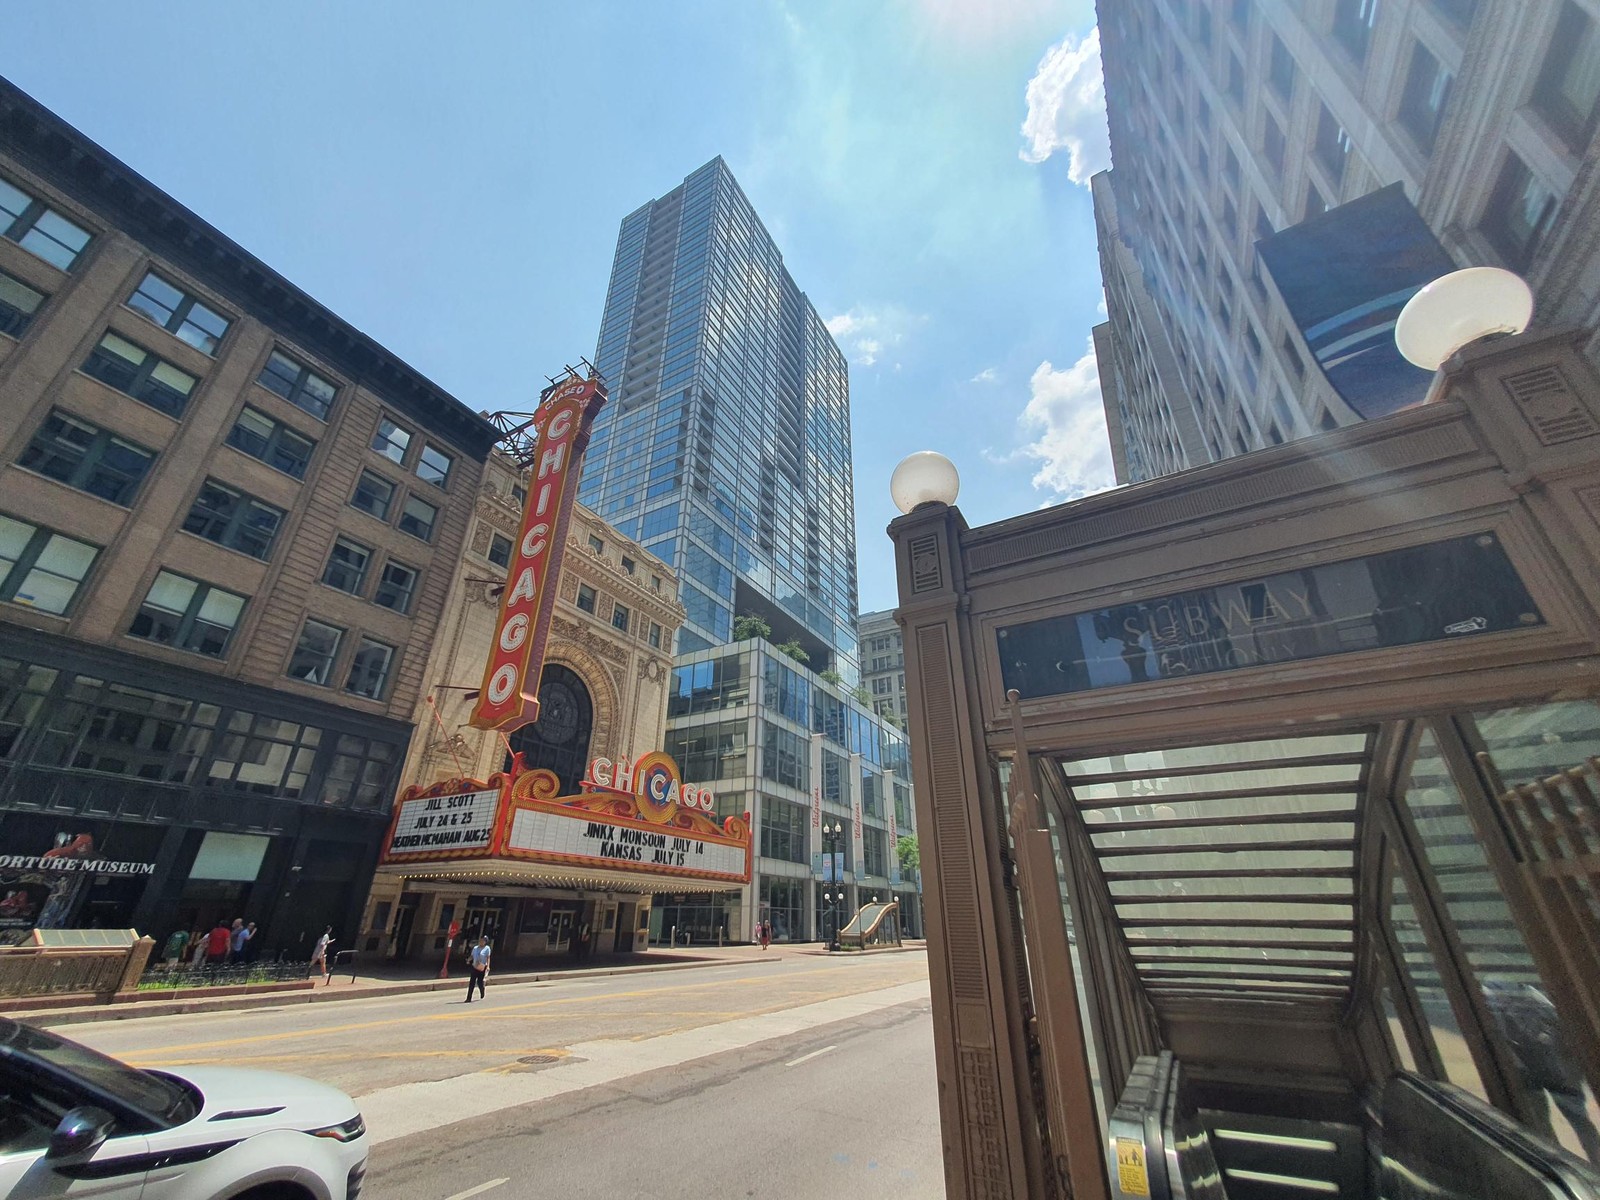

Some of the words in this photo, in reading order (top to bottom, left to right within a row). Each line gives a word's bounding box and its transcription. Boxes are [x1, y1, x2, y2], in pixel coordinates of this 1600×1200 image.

[545, 386, 577, 411] CHASE
[487, 409, 573, 706] CHICAGO
[1123, 586, 1313, 647] SUBWAY
[590, 757, 714, 811] CHICAGO
[425, 798, 442, 811] JILL
[447, 794, 476, 809] SCOTT
[414, 815, 436, 829] JULY
[437, 814, 449, 827] 24
[450, 813, 458, 826] &
[461, 812, 474, 825] 25
[583, 822, 615, 841] JINKX
[620, 828, 666, 848] MONSOON
[671, 837, 691, 853] JULY
[695, 841, 704, 855] 14
[600, 841, 642, 861] KANSAS
[652, 849, 674, 865] JULY
[676, 852, 685, 866] 15
[79, 860, 156, 874] MUSEUM
